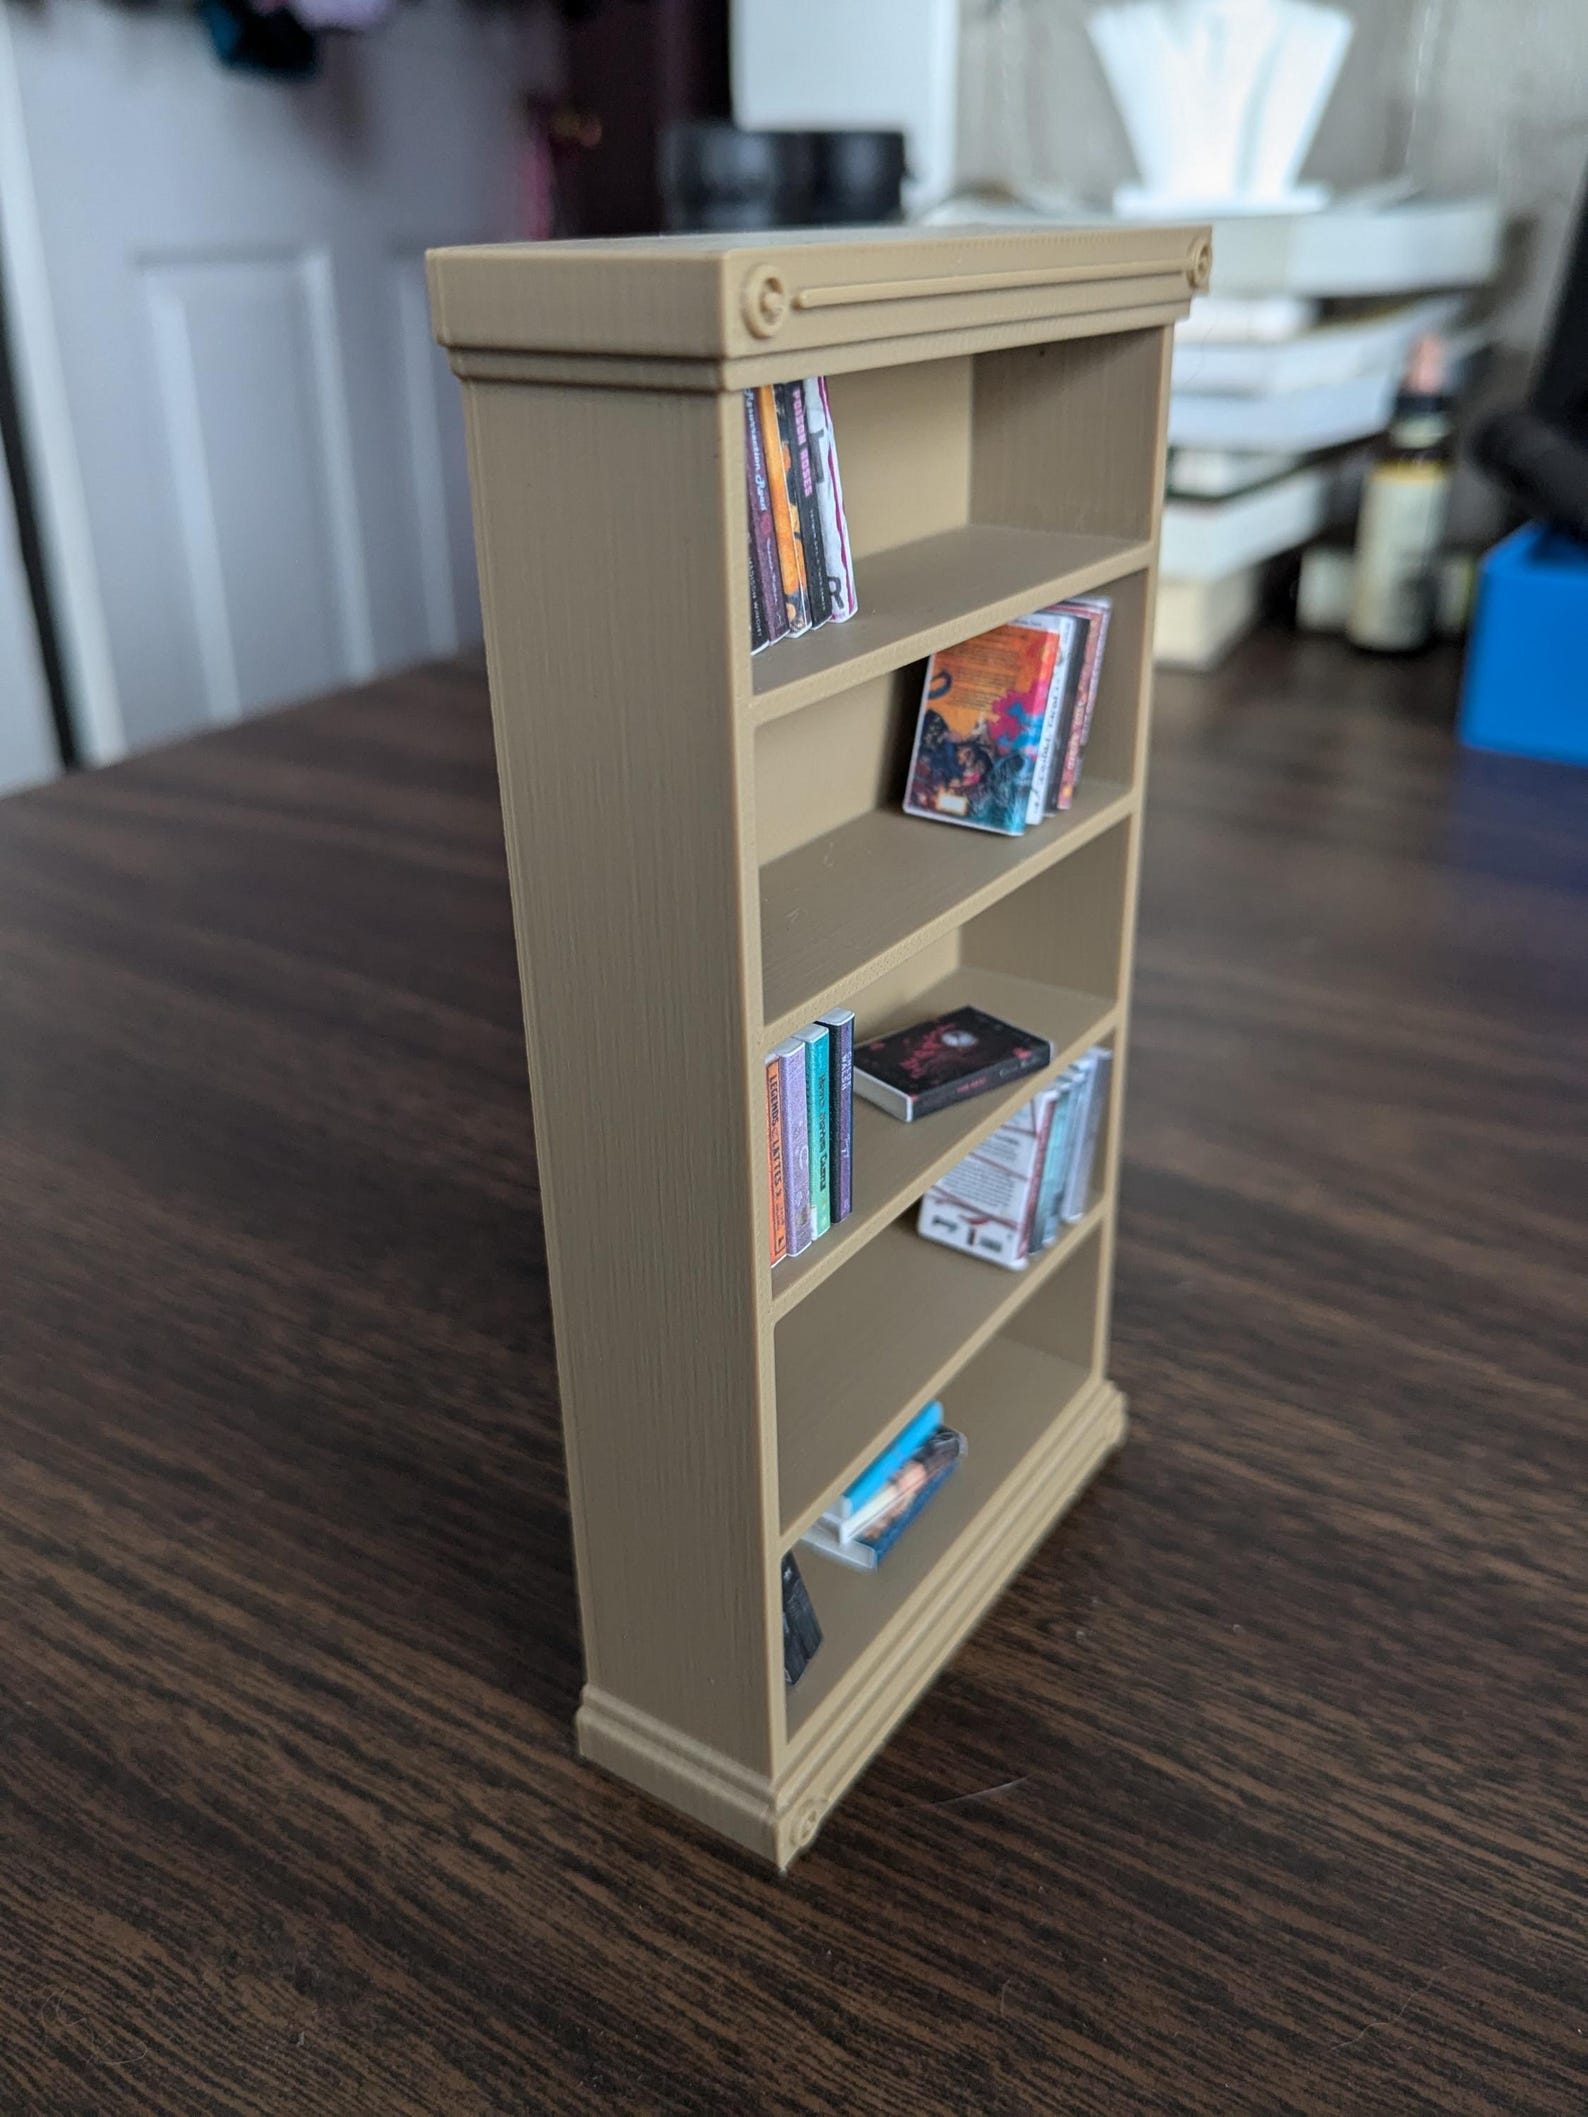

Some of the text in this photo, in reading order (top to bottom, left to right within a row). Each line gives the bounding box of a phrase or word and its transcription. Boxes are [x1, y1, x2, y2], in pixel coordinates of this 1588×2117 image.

[793, 388, 813, 497] POISON ROSES
[769, 1075, 779, 1127] LEGENDS
[772, 1140, 782, 1187] LATTES
